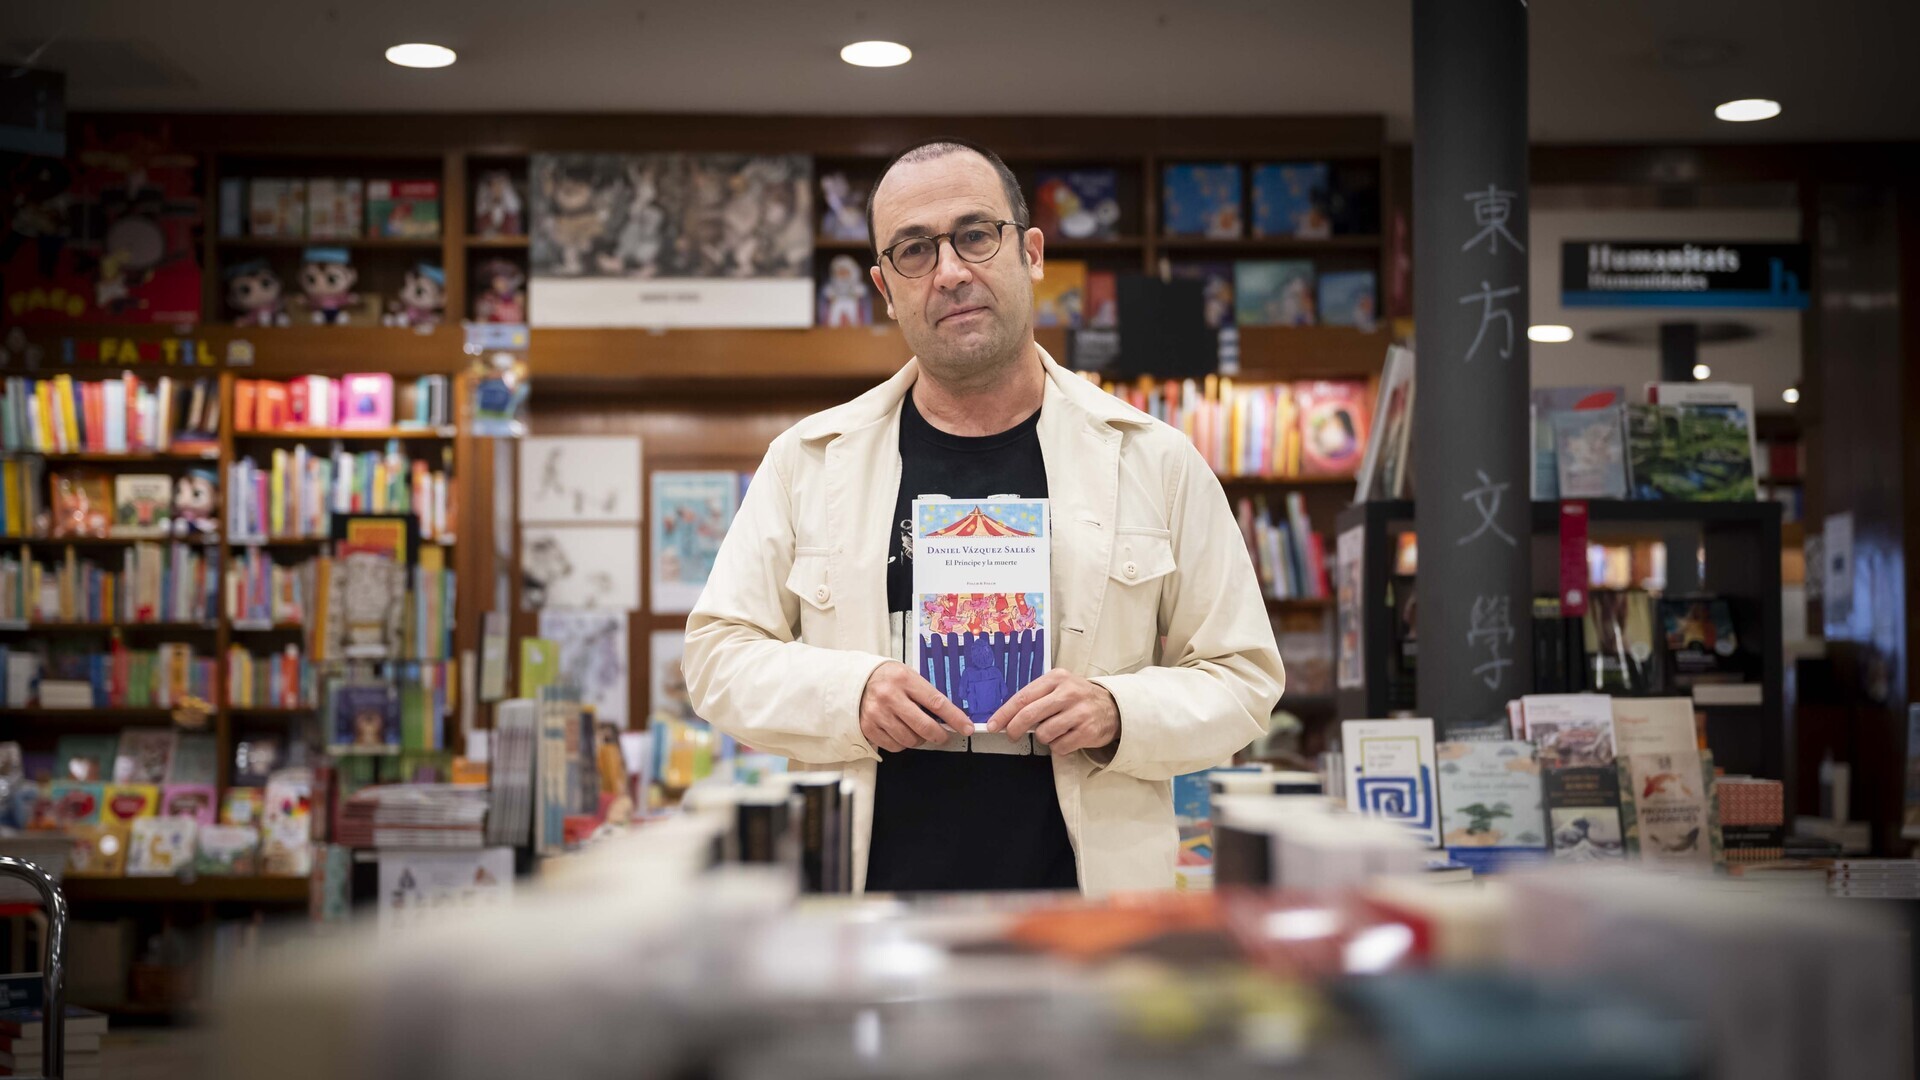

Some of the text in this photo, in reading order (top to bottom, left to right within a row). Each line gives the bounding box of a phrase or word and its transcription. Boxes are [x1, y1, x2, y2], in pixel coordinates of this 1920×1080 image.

[1588, 244, 1740, 272] Humanitats
[1588, 273, 1708, 291] Humanidades
[927, 545, 1036, 555] DANIEL VÁZQUEZ SALLÉS
